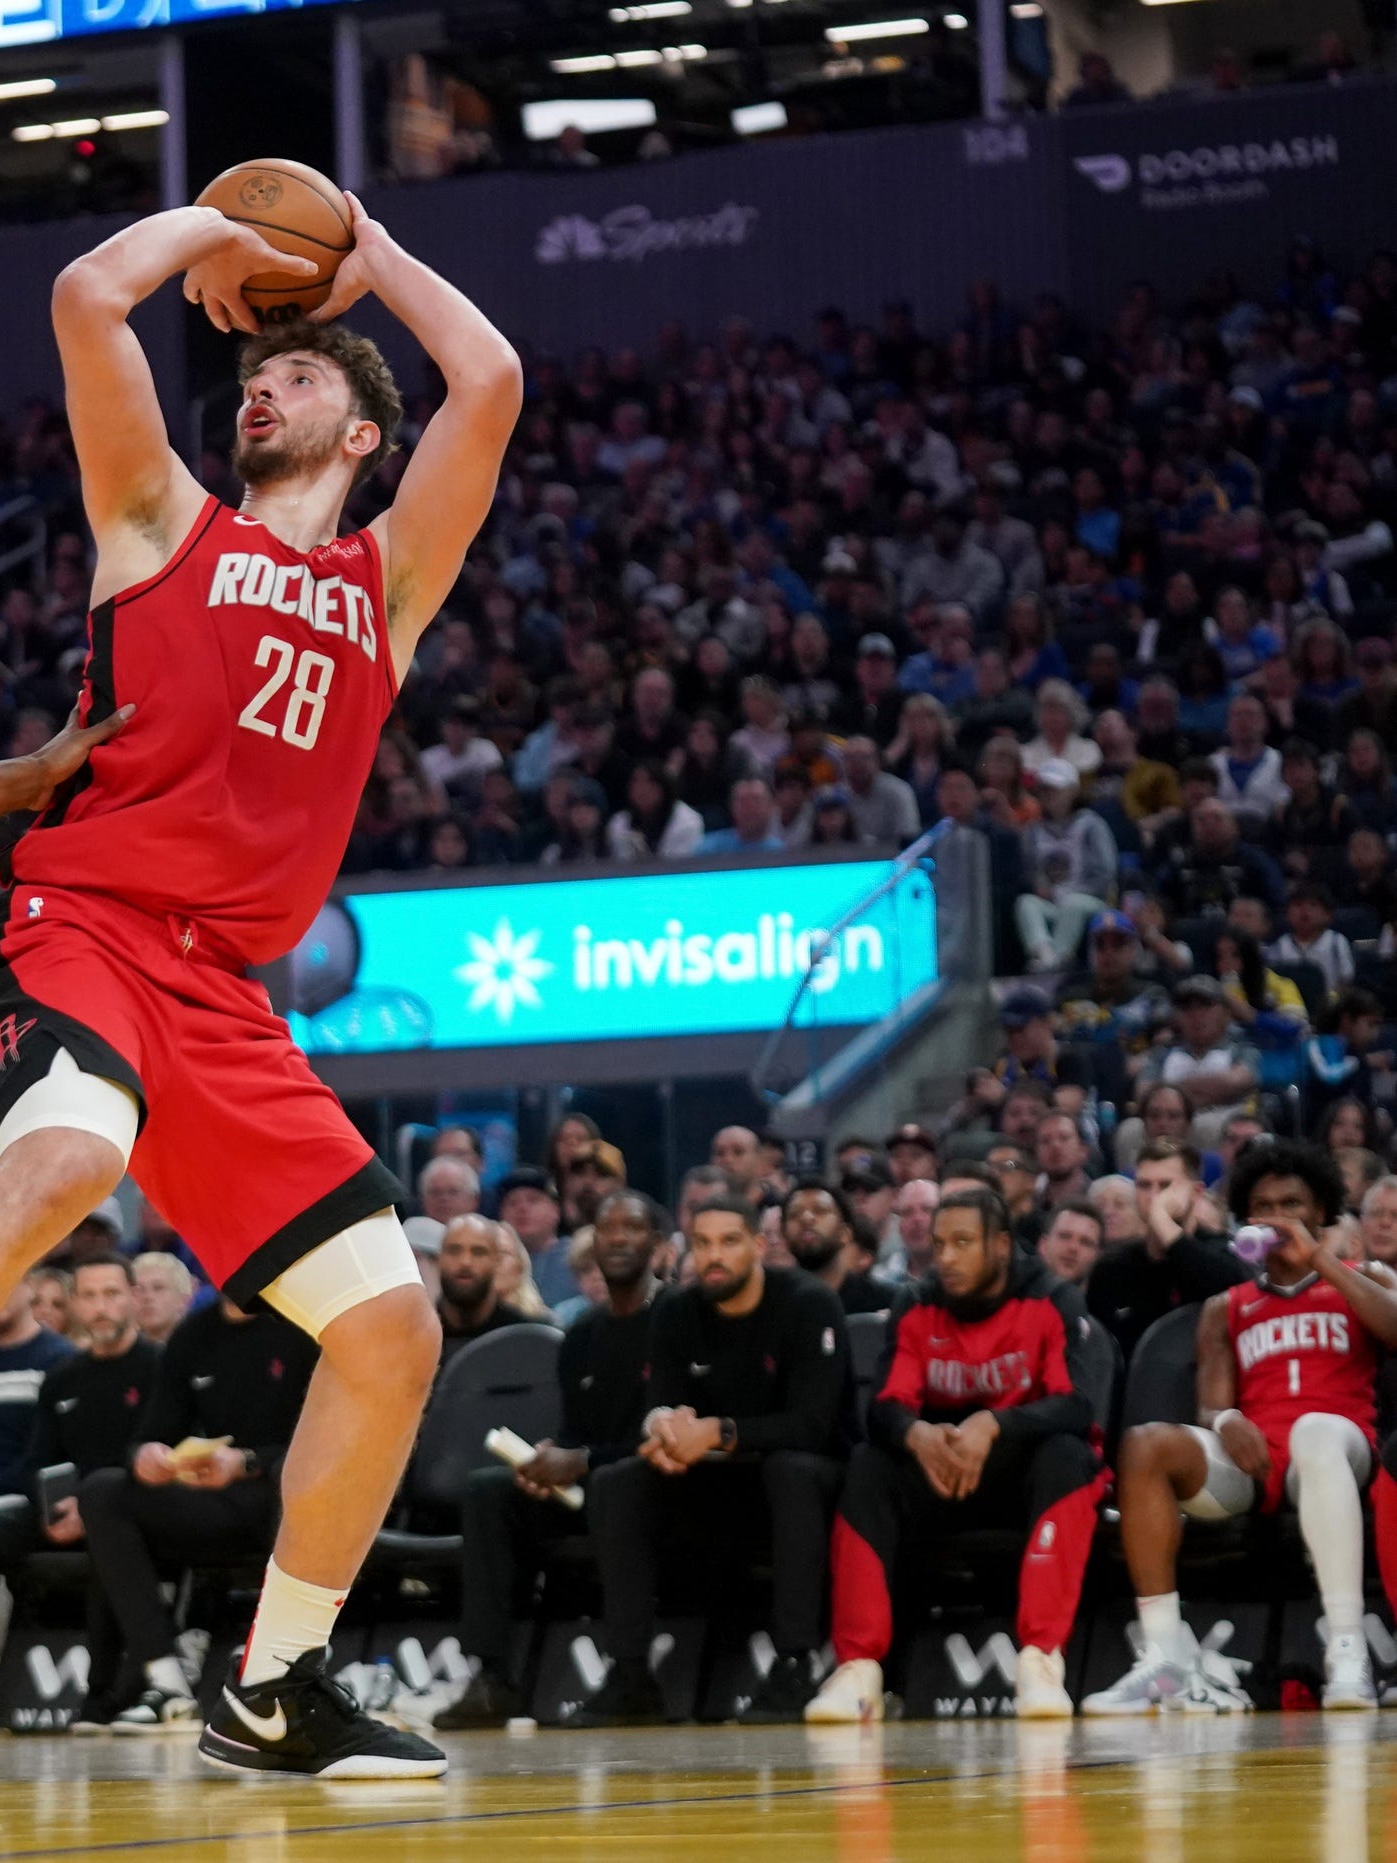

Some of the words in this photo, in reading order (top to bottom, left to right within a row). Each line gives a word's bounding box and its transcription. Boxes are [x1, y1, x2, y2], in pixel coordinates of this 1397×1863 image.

[1139, 134, 1339, 184] DOORDASH
[206, 552, 378, 664] ROCKETS
[237, 634, 336, 751] 28
[573, 911, 885, 994] invisalign
[1236, 1311, 1351, 1373] ROCKETS
[1287, 1357, 1301, 1397] 1
